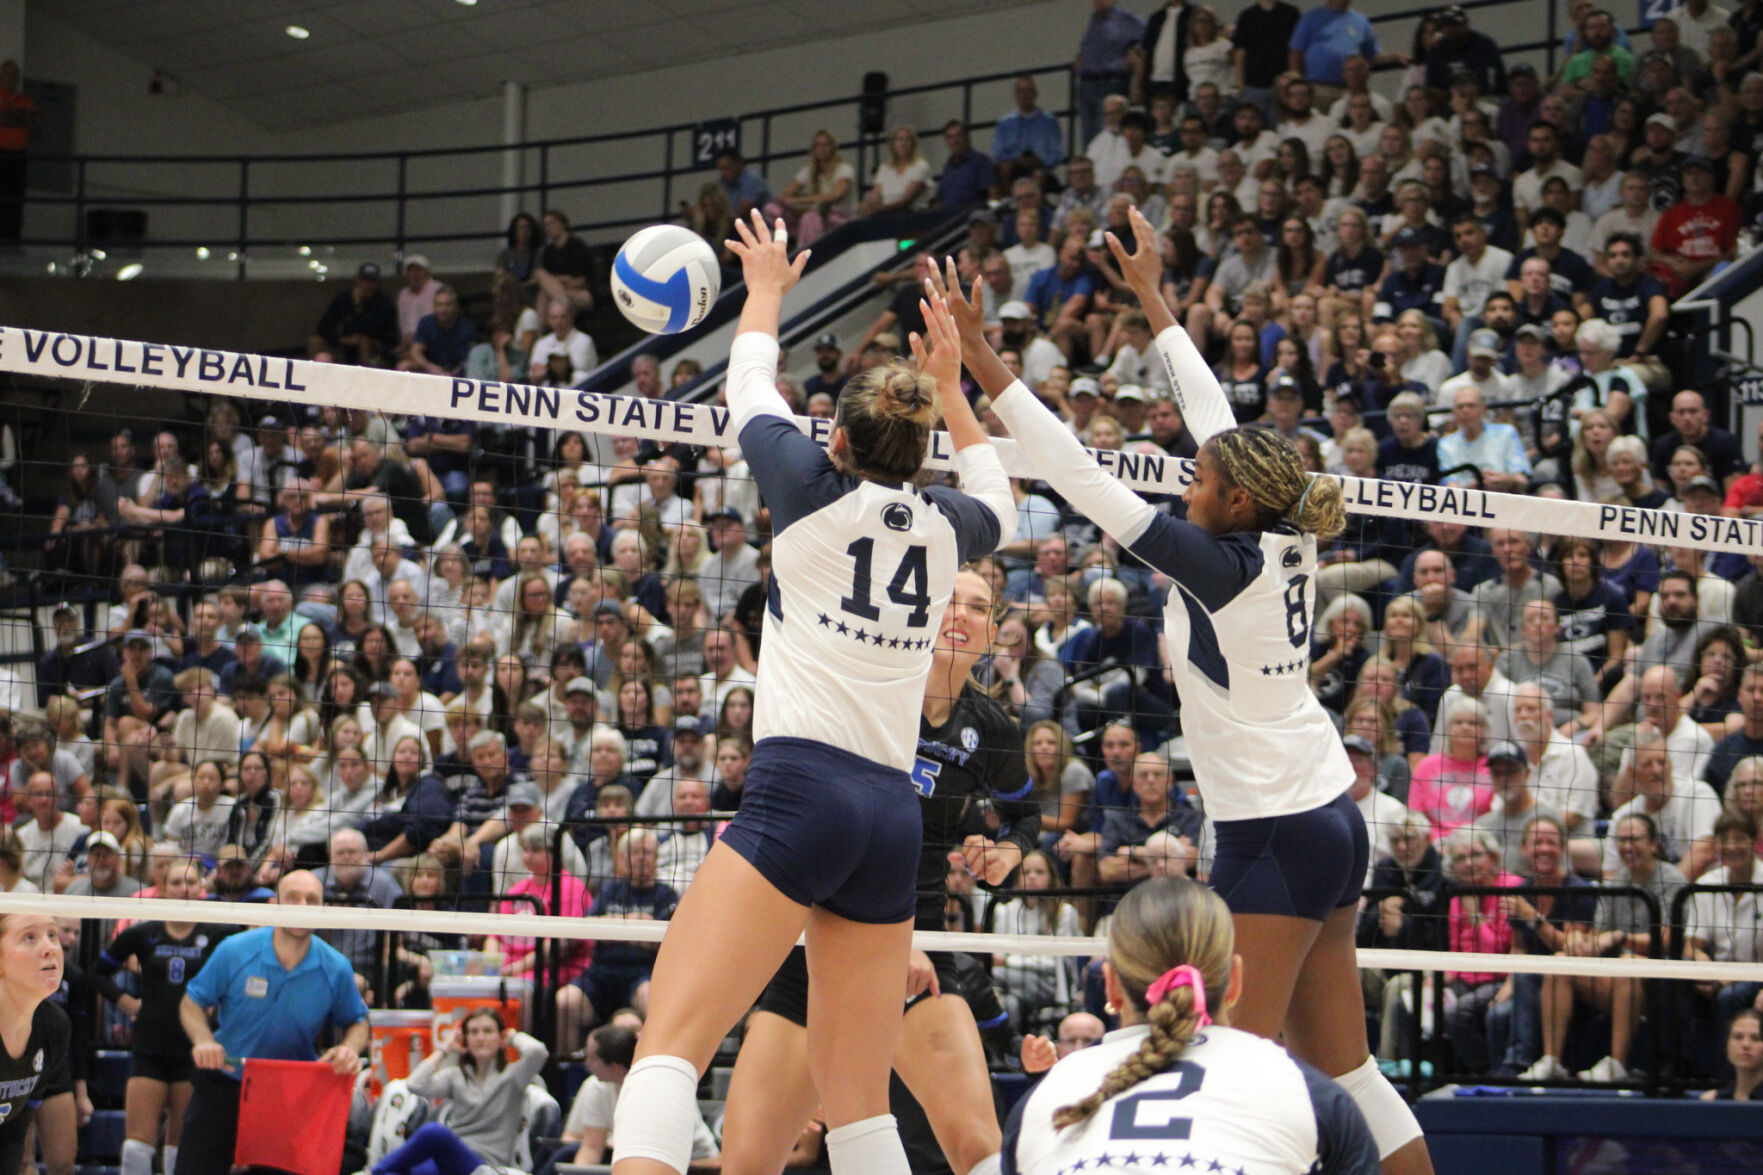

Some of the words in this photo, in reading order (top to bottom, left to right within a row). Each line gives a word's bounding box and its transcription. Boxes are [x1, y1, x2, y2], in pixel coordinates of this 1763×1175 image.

[699, 130, 735, 160] 211
[22, 329, 306, 391] VOLLEYBALL
[450, 378, 561, 420] PENN
[575, 393, 695, 433] STATE
[1086, 449, 1165, 483] ENN
[1340, 477, 1495, 519] LLEYBALL
[1600, 505, 1679, 538] PENN
[1690, 515, 1763, 545] STAT
[841, 536, 931, 627] 14
[1284, 574, 1309, 649] 8
[911, 754, 942, 799] 5
[1109, 1059, 1206, 1140] 2
